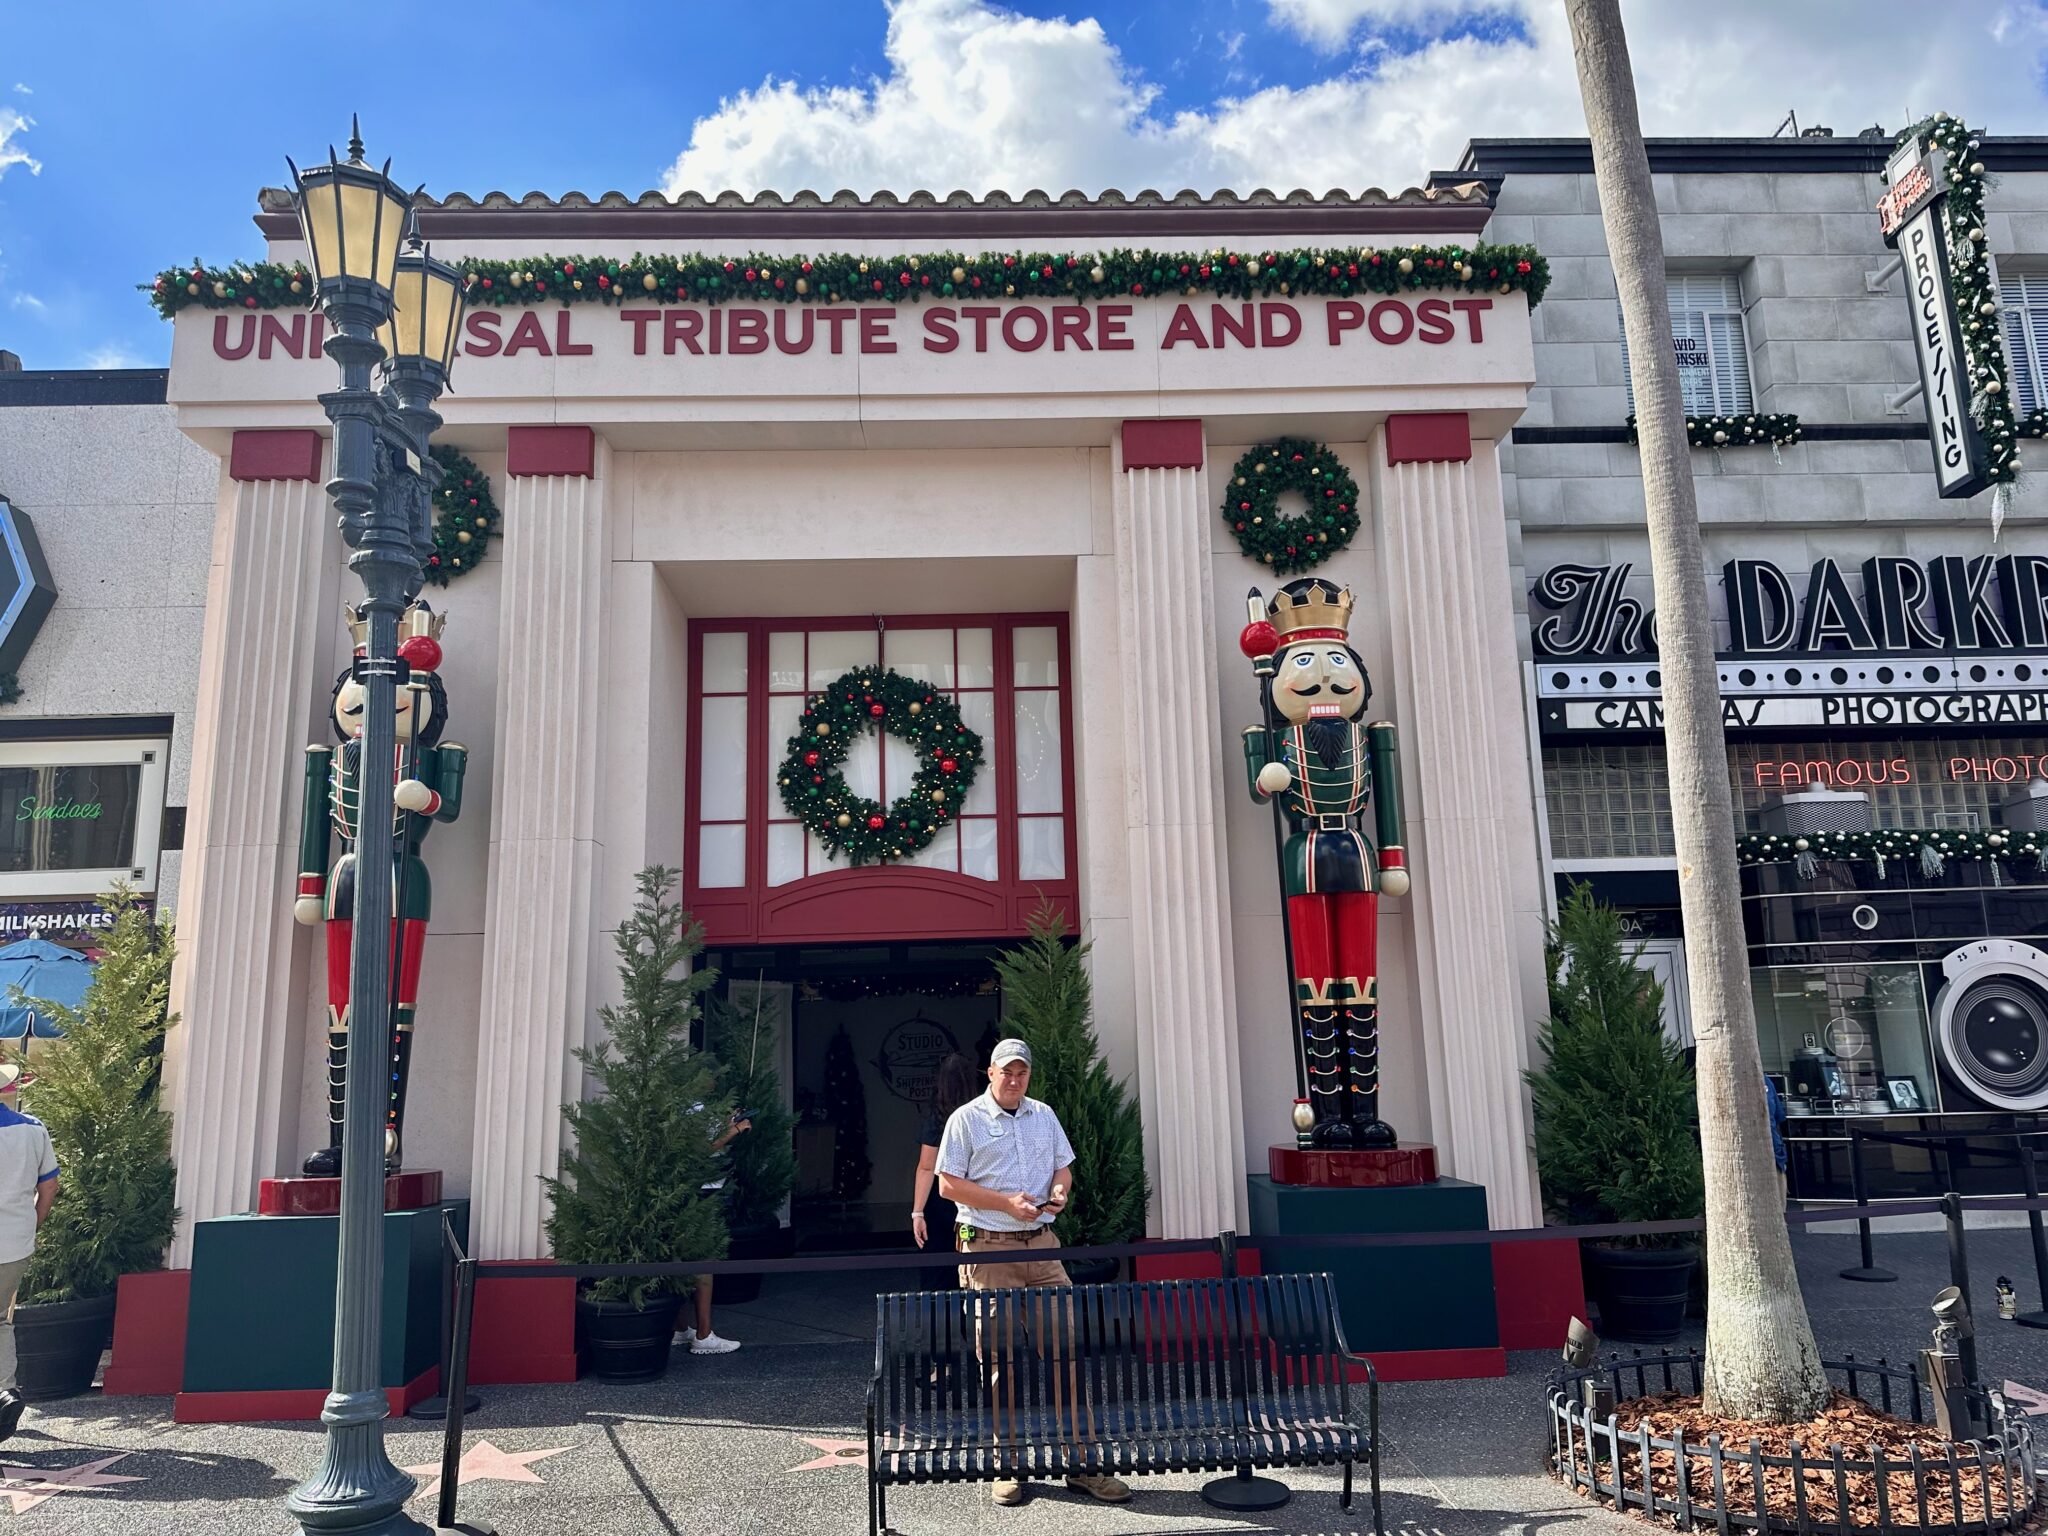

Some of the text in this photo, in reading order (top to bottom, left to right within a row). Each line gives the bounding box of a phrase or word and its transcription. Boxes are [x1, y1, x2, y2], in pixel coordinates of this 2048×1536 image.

[213, 298, 1494, 361] UNISAL TRIBUTE STORE AND POST
[1755, 758, 1911, 787] FAMOUS
[16, 796, 103, 820] Sundaes
[898, 1034, 944, 1050] STUDIO
